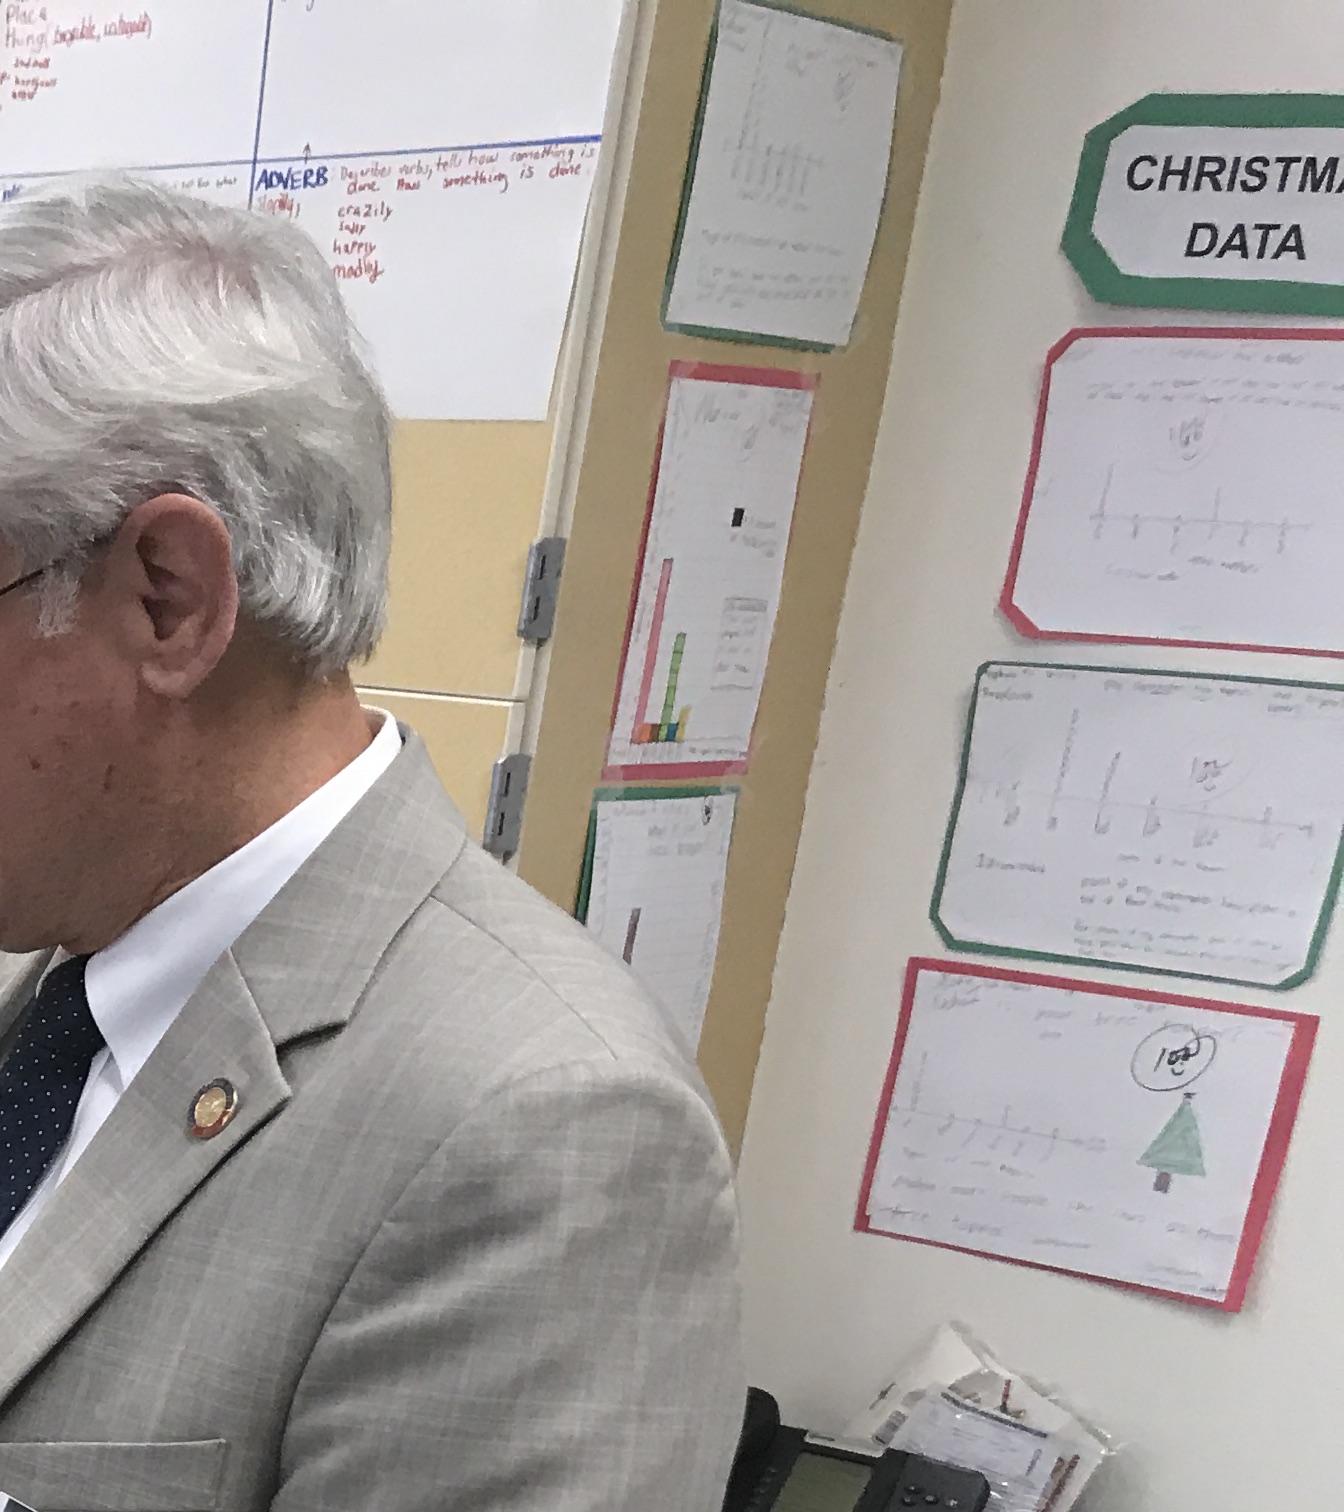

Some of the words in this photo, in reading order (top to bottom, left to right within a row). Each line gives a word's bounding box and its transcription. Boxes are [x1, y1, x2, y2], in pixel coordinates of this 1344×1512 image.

[255, 166, 328, 191] ADVERB
[519, 164, 534, 179] is
[1126, 154, 1344, 193] CHRISTM
[337, 200, 393, 222] crazily
[1184, 222, 1307, 260] DATA
